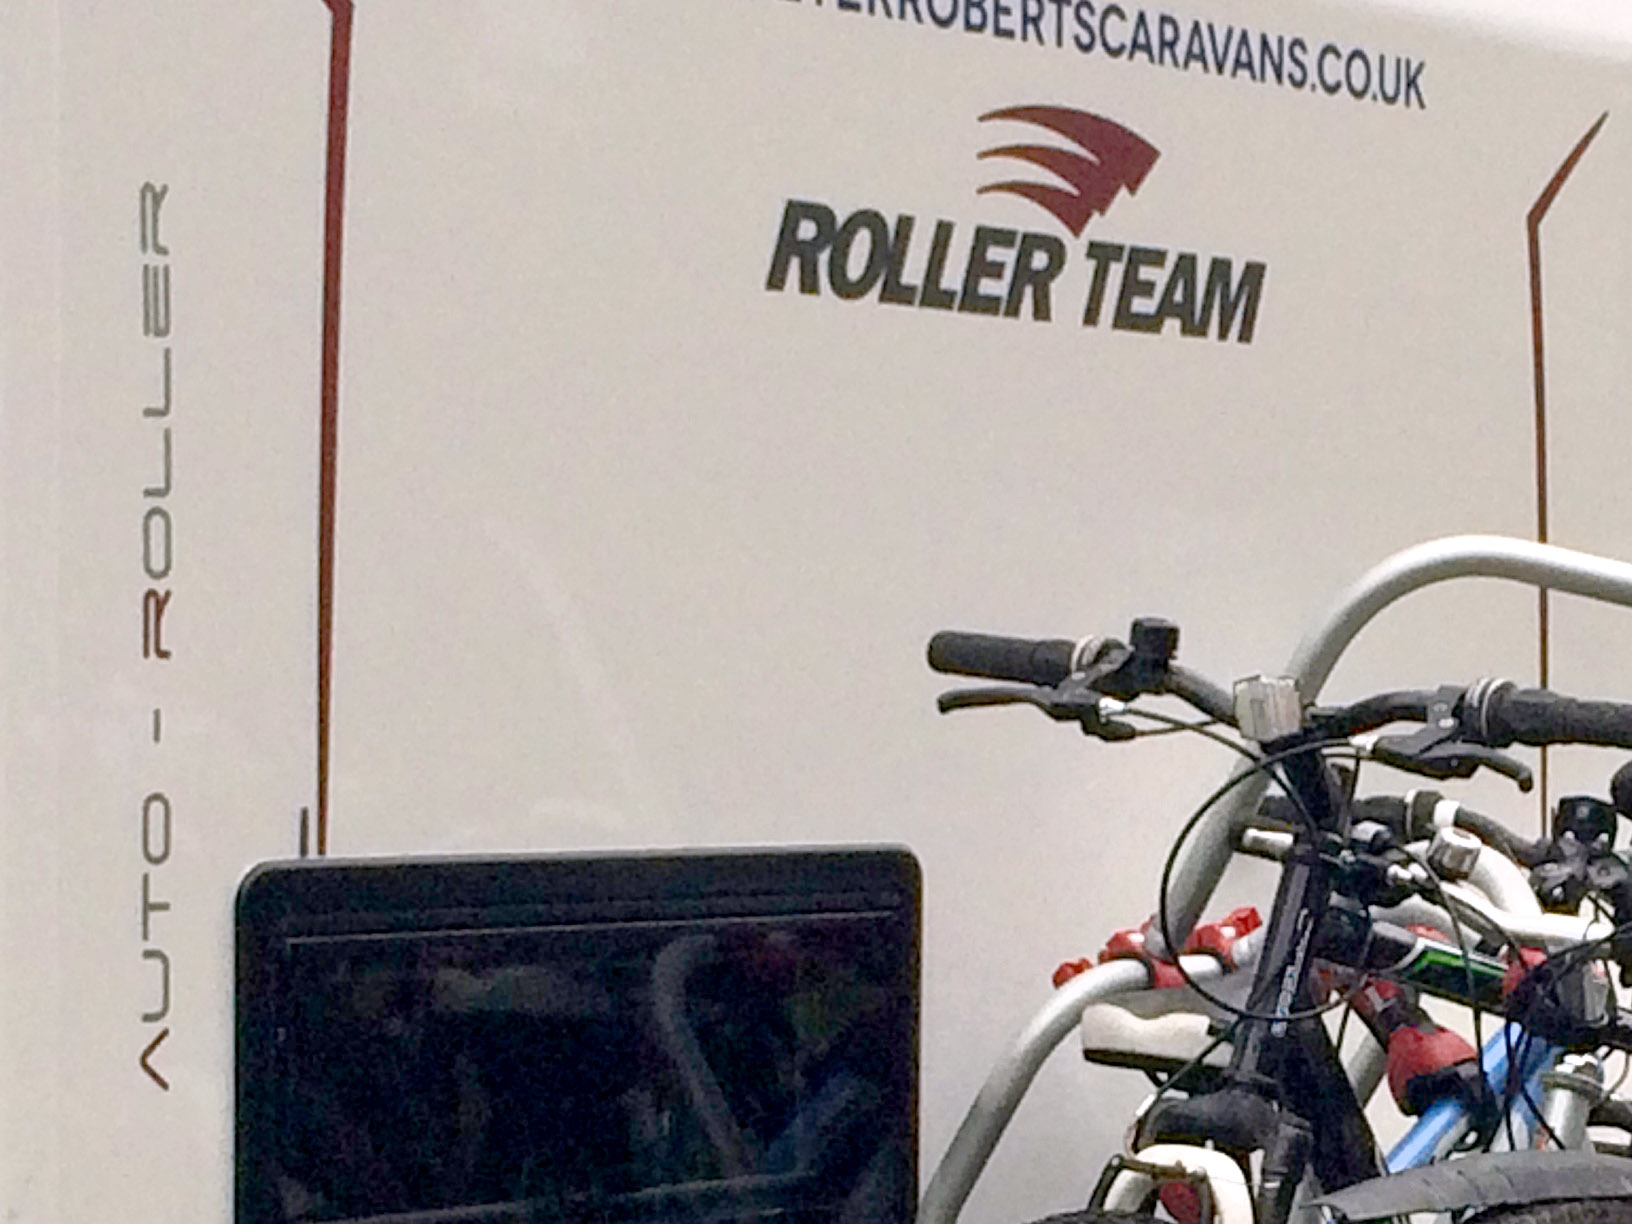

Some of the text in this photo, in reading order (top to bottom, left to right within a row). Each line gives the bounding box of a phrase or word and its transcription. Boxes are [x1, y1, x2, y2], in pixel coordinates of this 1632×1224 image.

[778, 0, 1427, 110] OBERTSCARAVANS.CO.UK
[764, 198, 1267, 345] ROLLER TEAM
[138, 180, 173, 660] ROLLER
[139, 792, 172, 1091] AUTO
